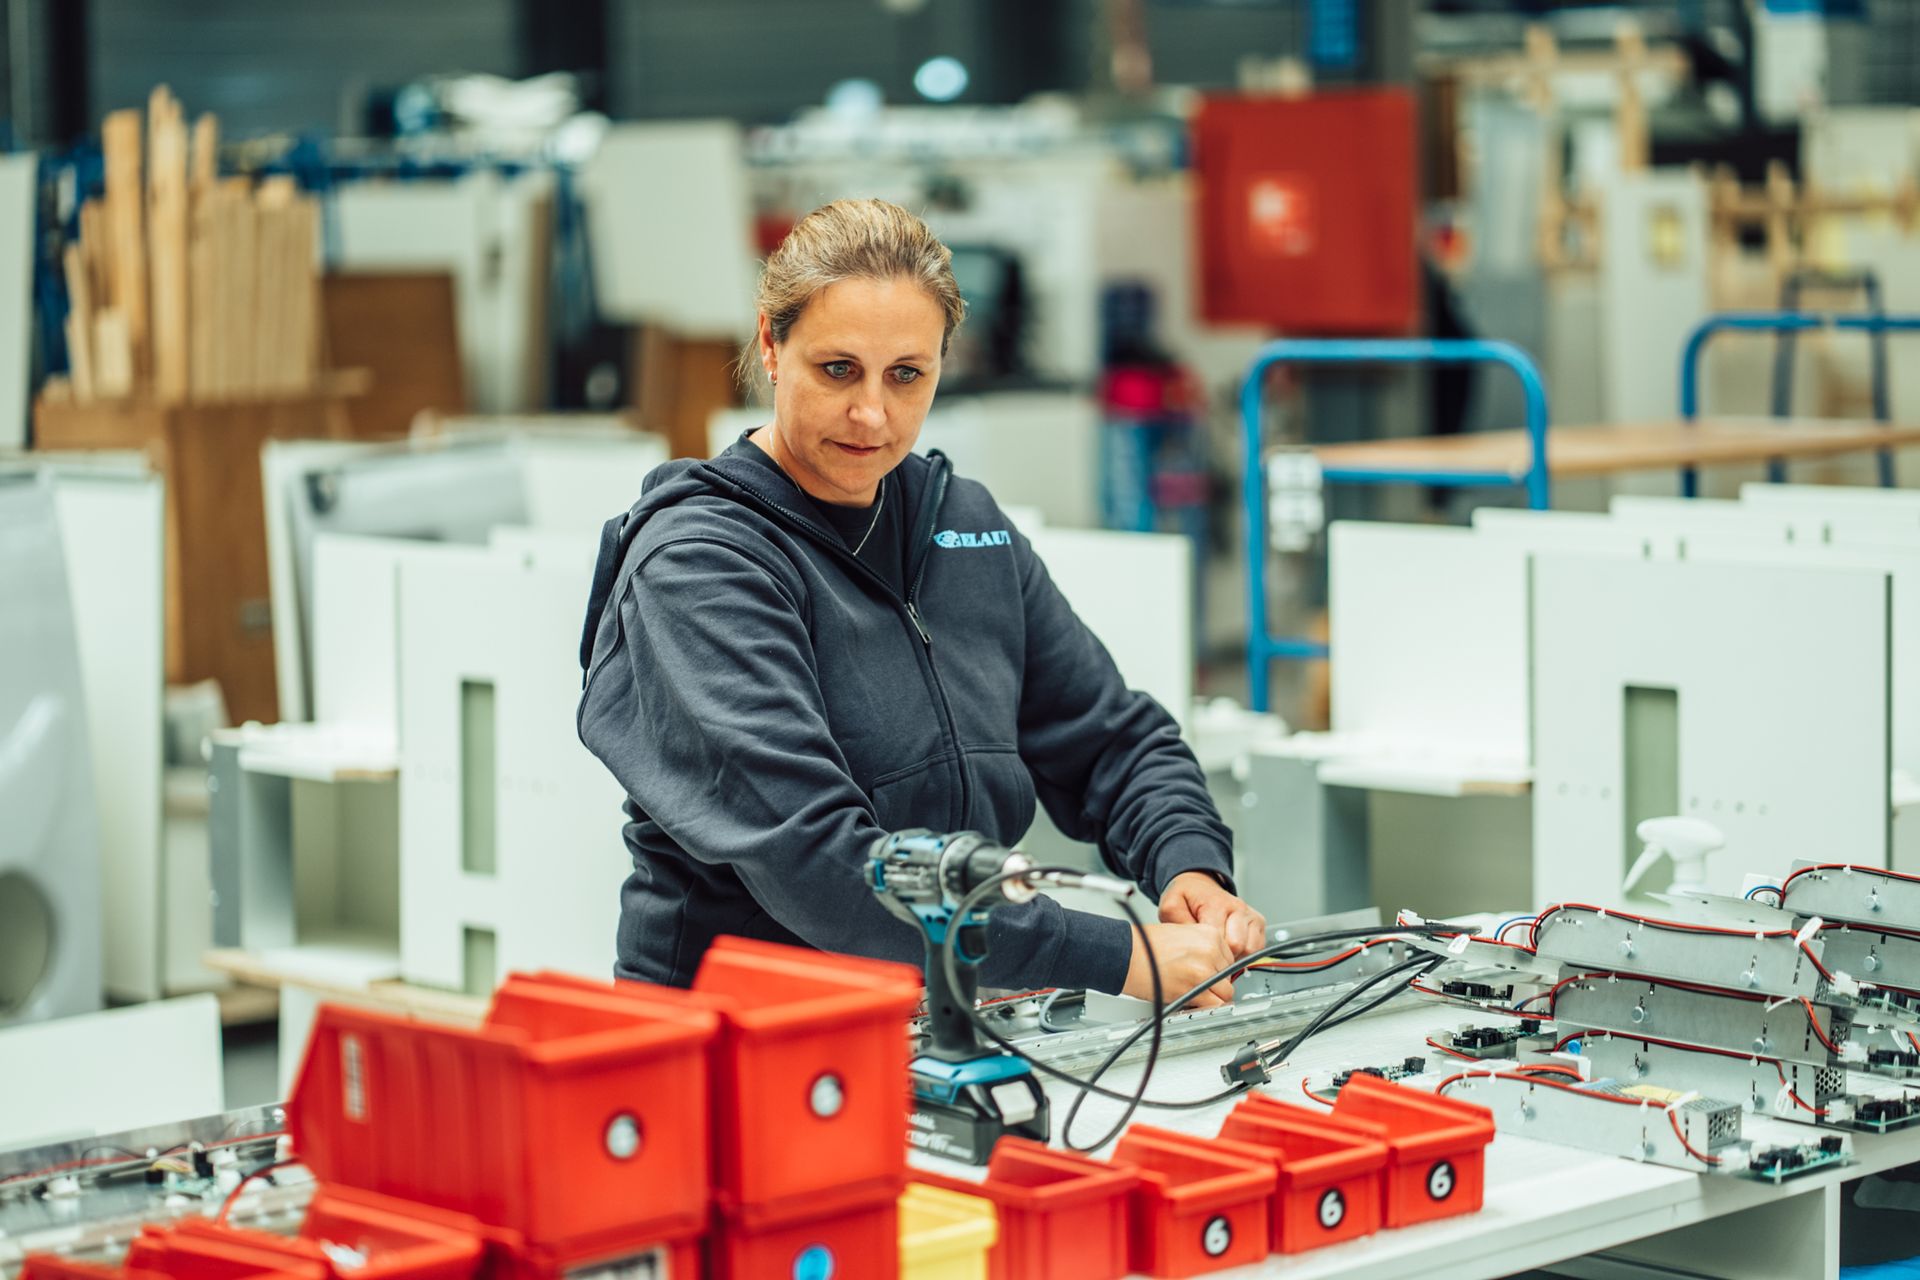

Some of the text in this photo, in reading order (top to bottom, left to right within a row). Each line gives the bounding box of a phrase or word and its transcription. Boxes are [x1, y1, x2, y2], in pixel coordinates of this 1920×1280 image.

[1431, 1162, 1452, 1198] 6
[1320, 1190, 1344, 1227] 6
[1204, 1217, 1230, 1255] 6
